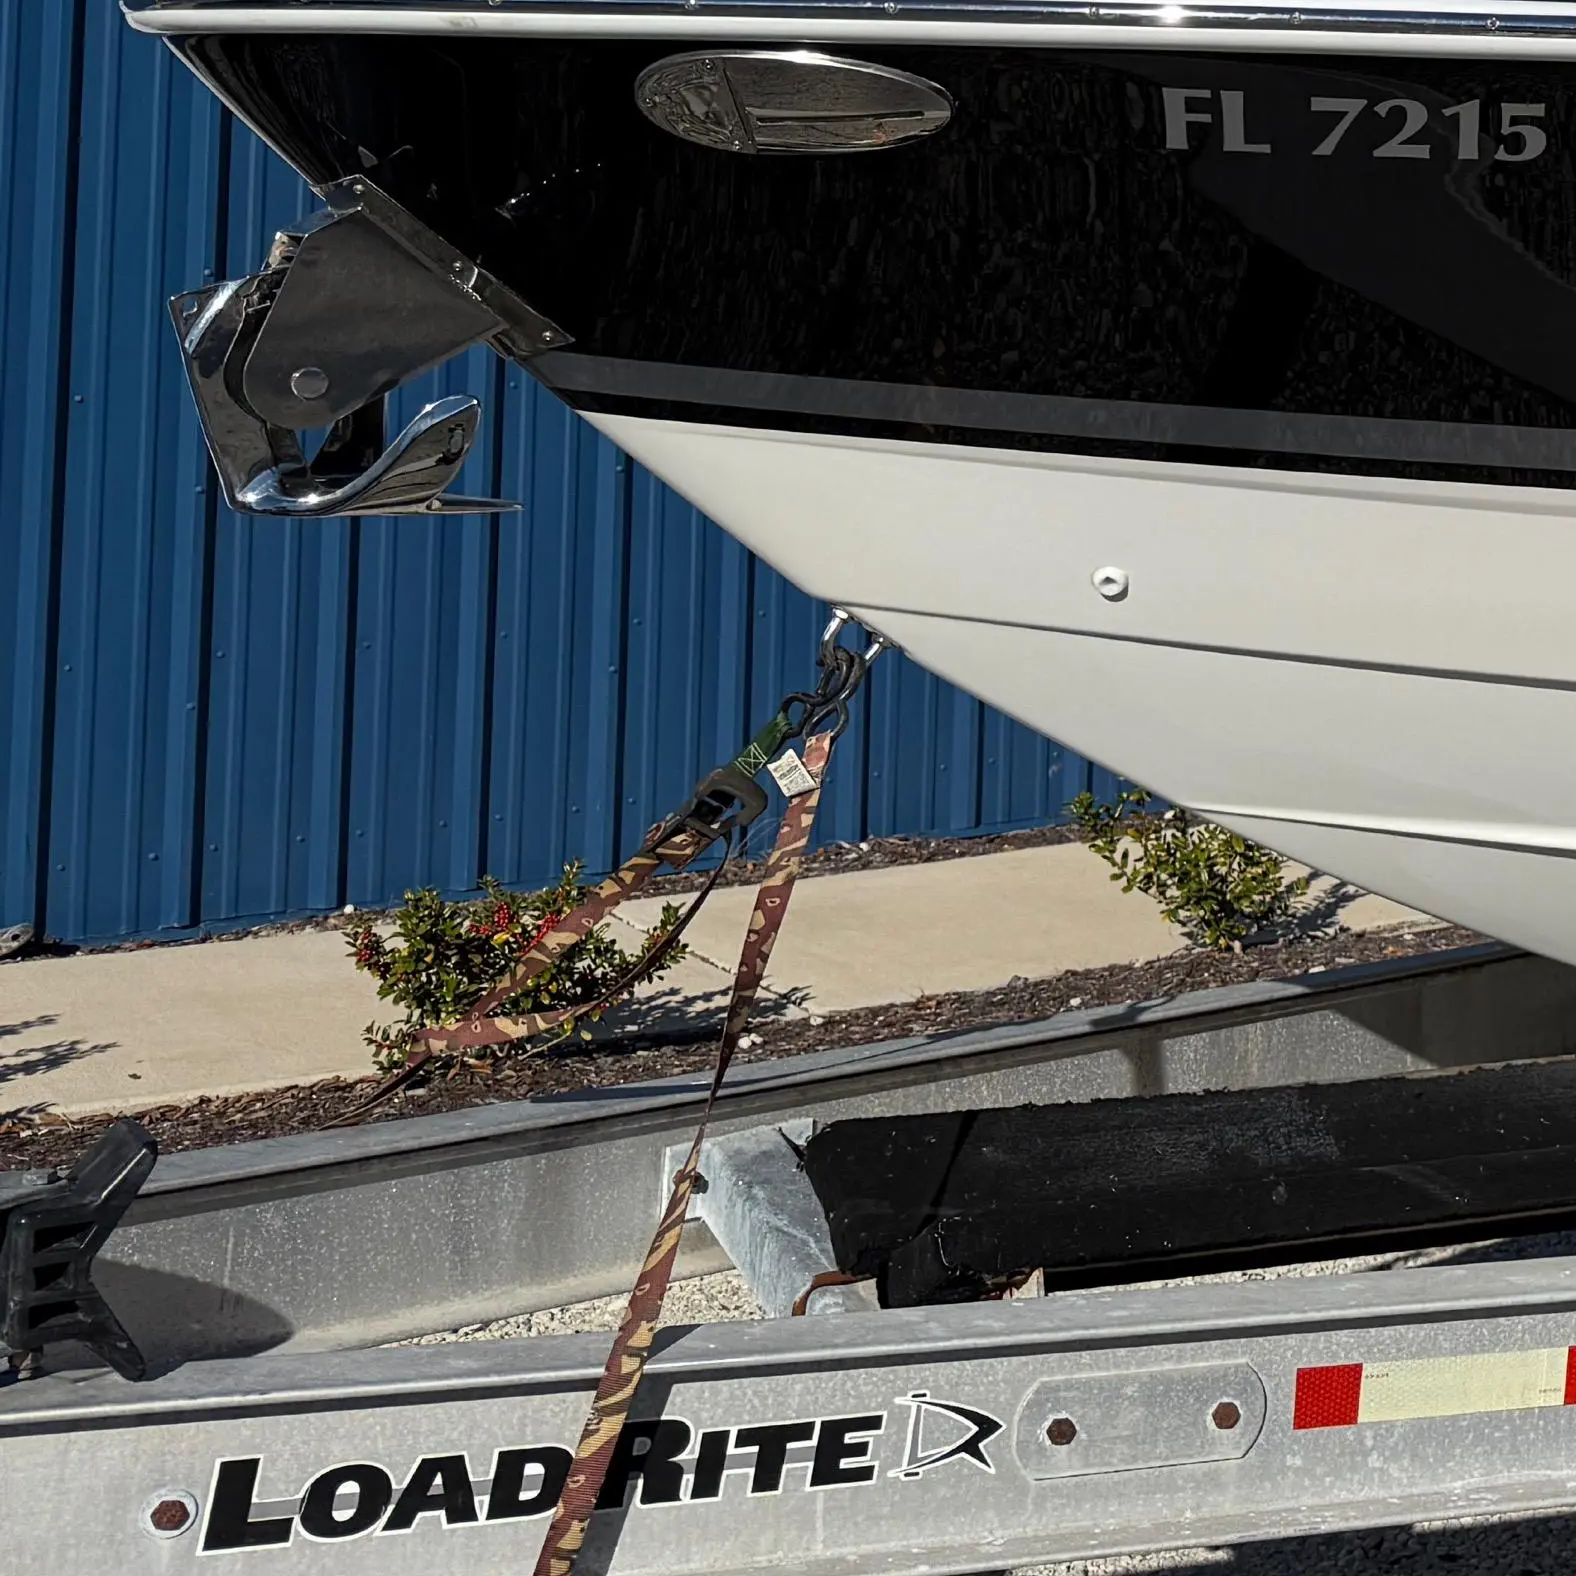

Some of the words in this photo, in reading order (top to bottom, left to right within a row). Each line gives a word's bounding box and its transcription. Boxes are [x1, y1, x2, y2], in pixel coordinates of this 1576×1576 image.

[1161, 86, 1272, 155] FL
[1309, 97, 1548, 162] 7215
[197, 1444, 572, 1556] LOAD
[594, 1410, 887, 1511] RITE
